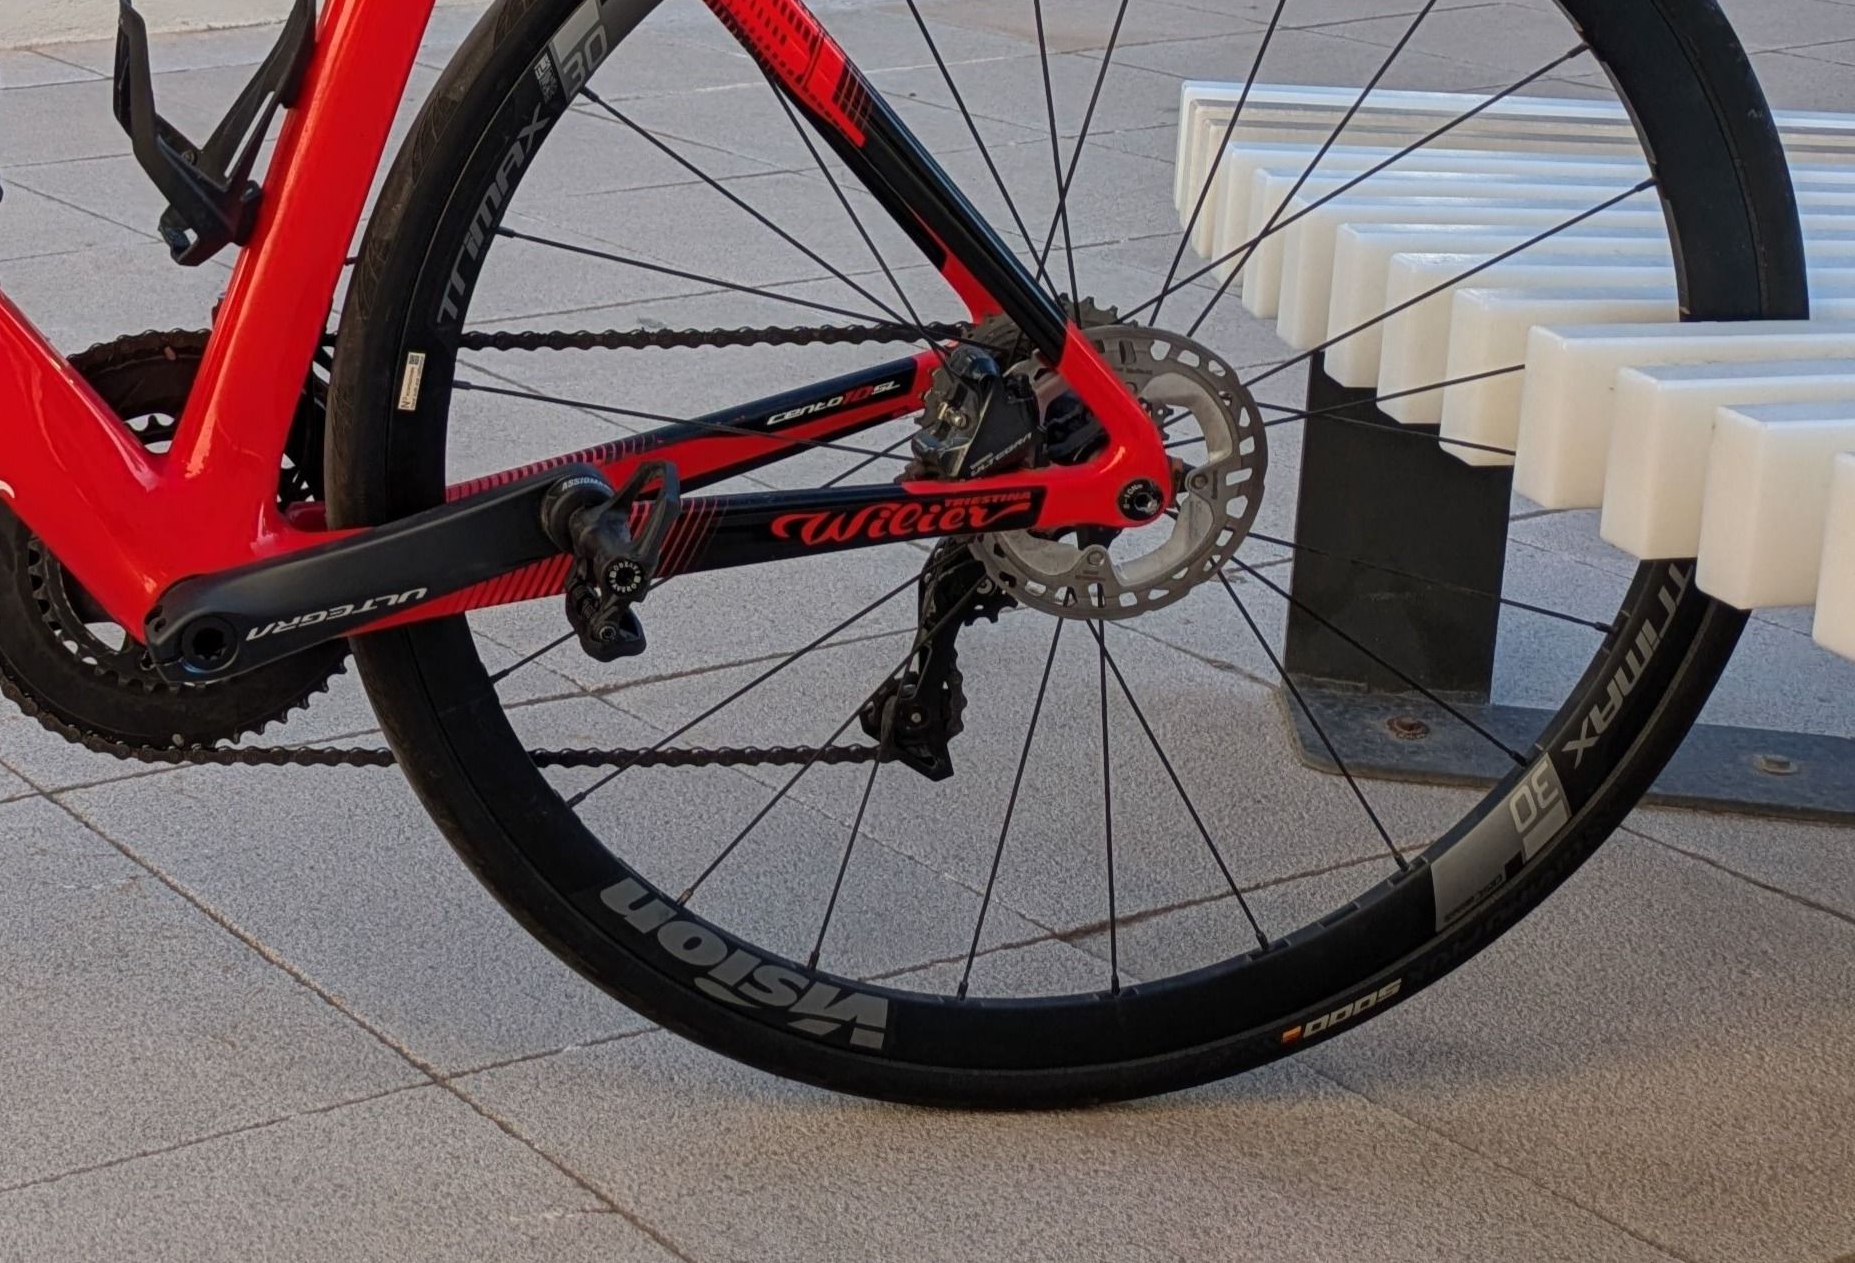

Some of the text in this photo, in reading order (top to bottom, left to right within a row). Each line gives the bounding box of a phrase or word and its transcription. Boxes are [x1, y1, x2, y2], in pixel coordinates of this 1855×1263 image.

[561, 24, 608, 100] 30
[770, 501, 1032, 547] Wilier
[945, 491, 1032, 507] TRIESTINA
[245, 587, 428, 641] ULTEGRA
[1509, 758, 1560, 834] 30
[1303, 977, 1402, 1041] 5000
